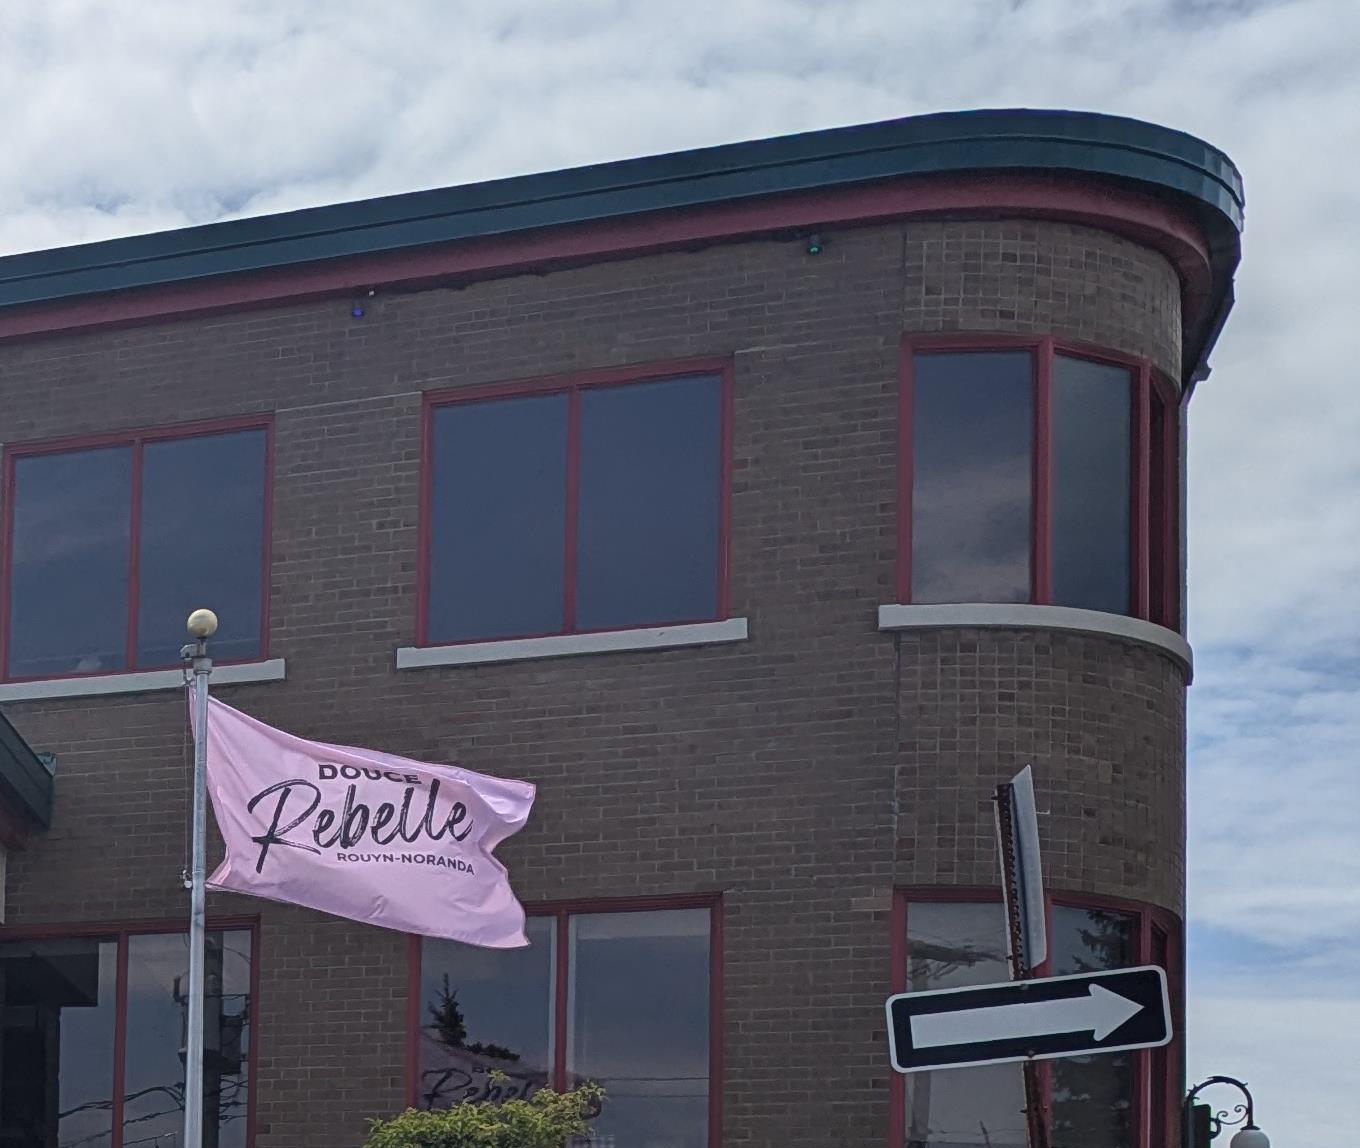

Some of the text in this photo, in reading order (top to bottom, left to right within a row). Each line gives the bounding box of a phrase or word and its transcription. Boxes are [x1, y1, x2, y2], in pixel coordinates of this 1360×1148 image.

[318, 763, 423, 785] DOUCE
[247, 778, 474, 874] Rebelle
[336, 851, 476, 876] ROUYN-NORANDA
